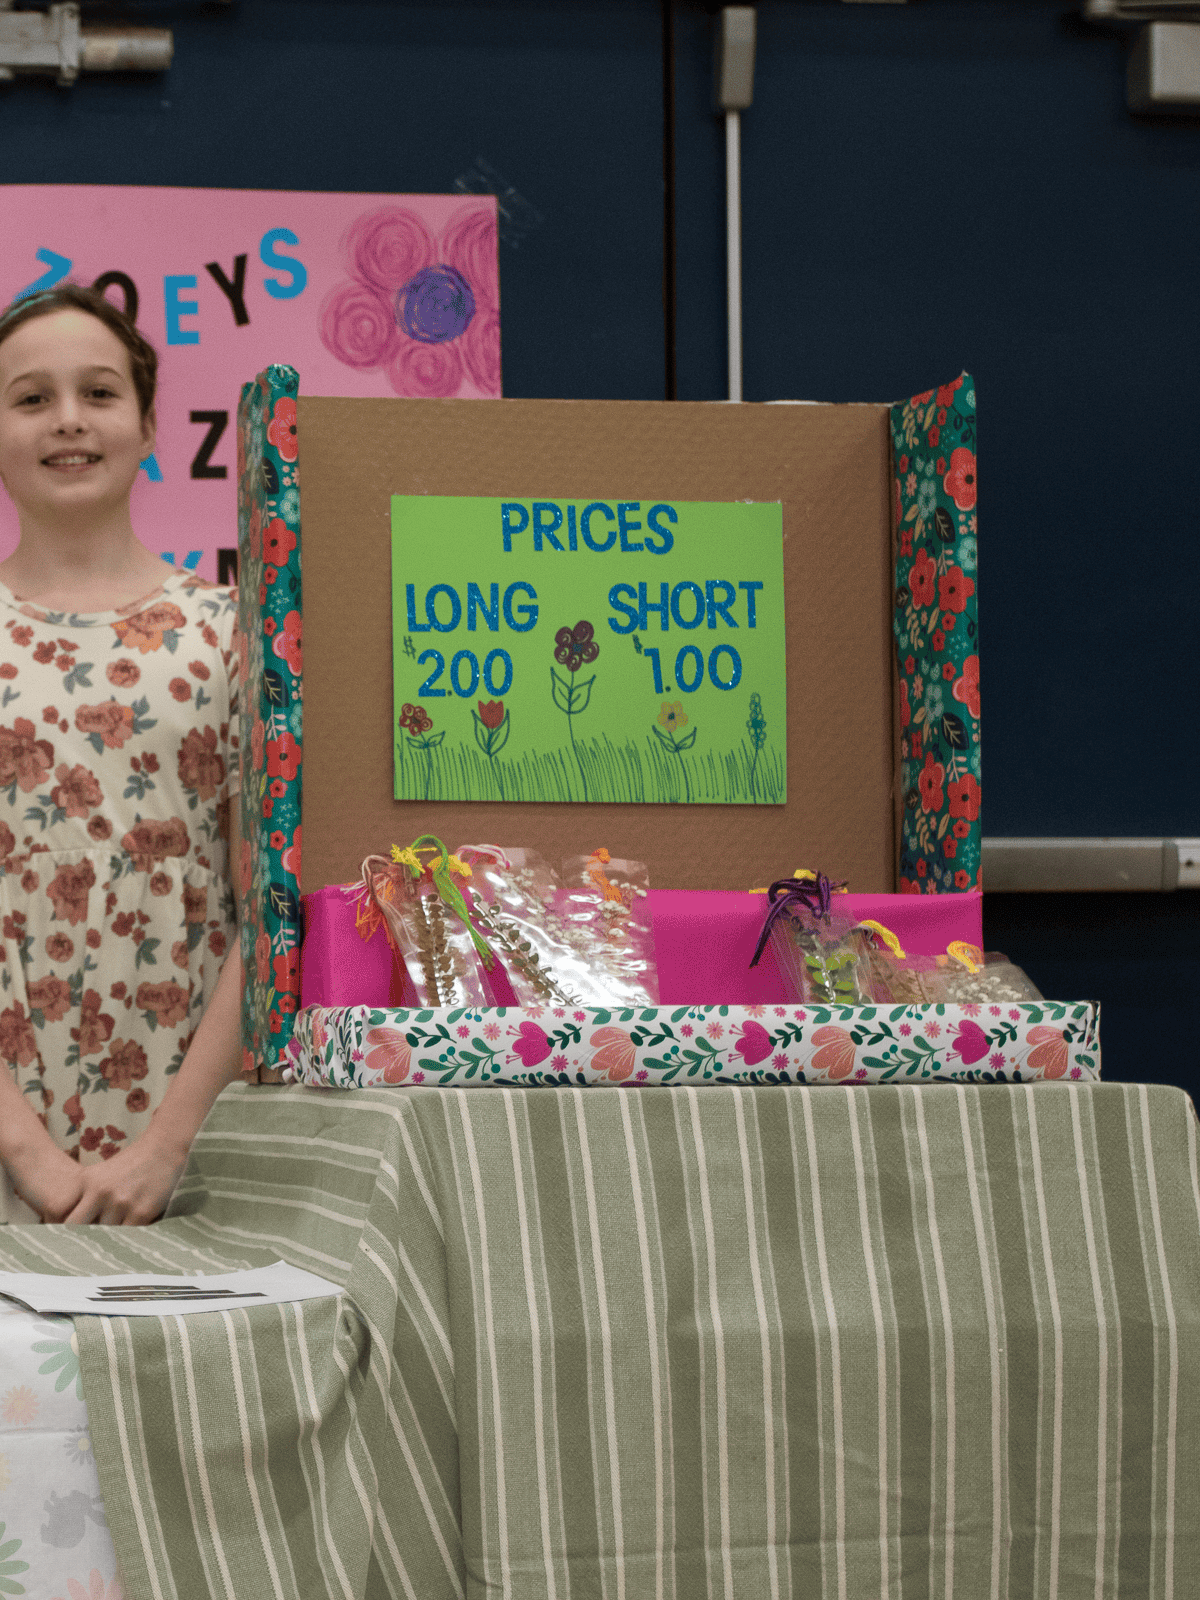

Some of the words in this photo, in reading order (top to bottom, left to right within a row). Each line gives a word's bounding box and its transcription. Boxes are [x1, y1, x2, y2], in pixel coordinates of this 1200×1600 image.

[15, 227, 308, 346] ZOEYS
[500, 502, 679, 555] PRICES
[405, 580, 540, 633] LONG
[607, 579, 764, 634] SHORT
